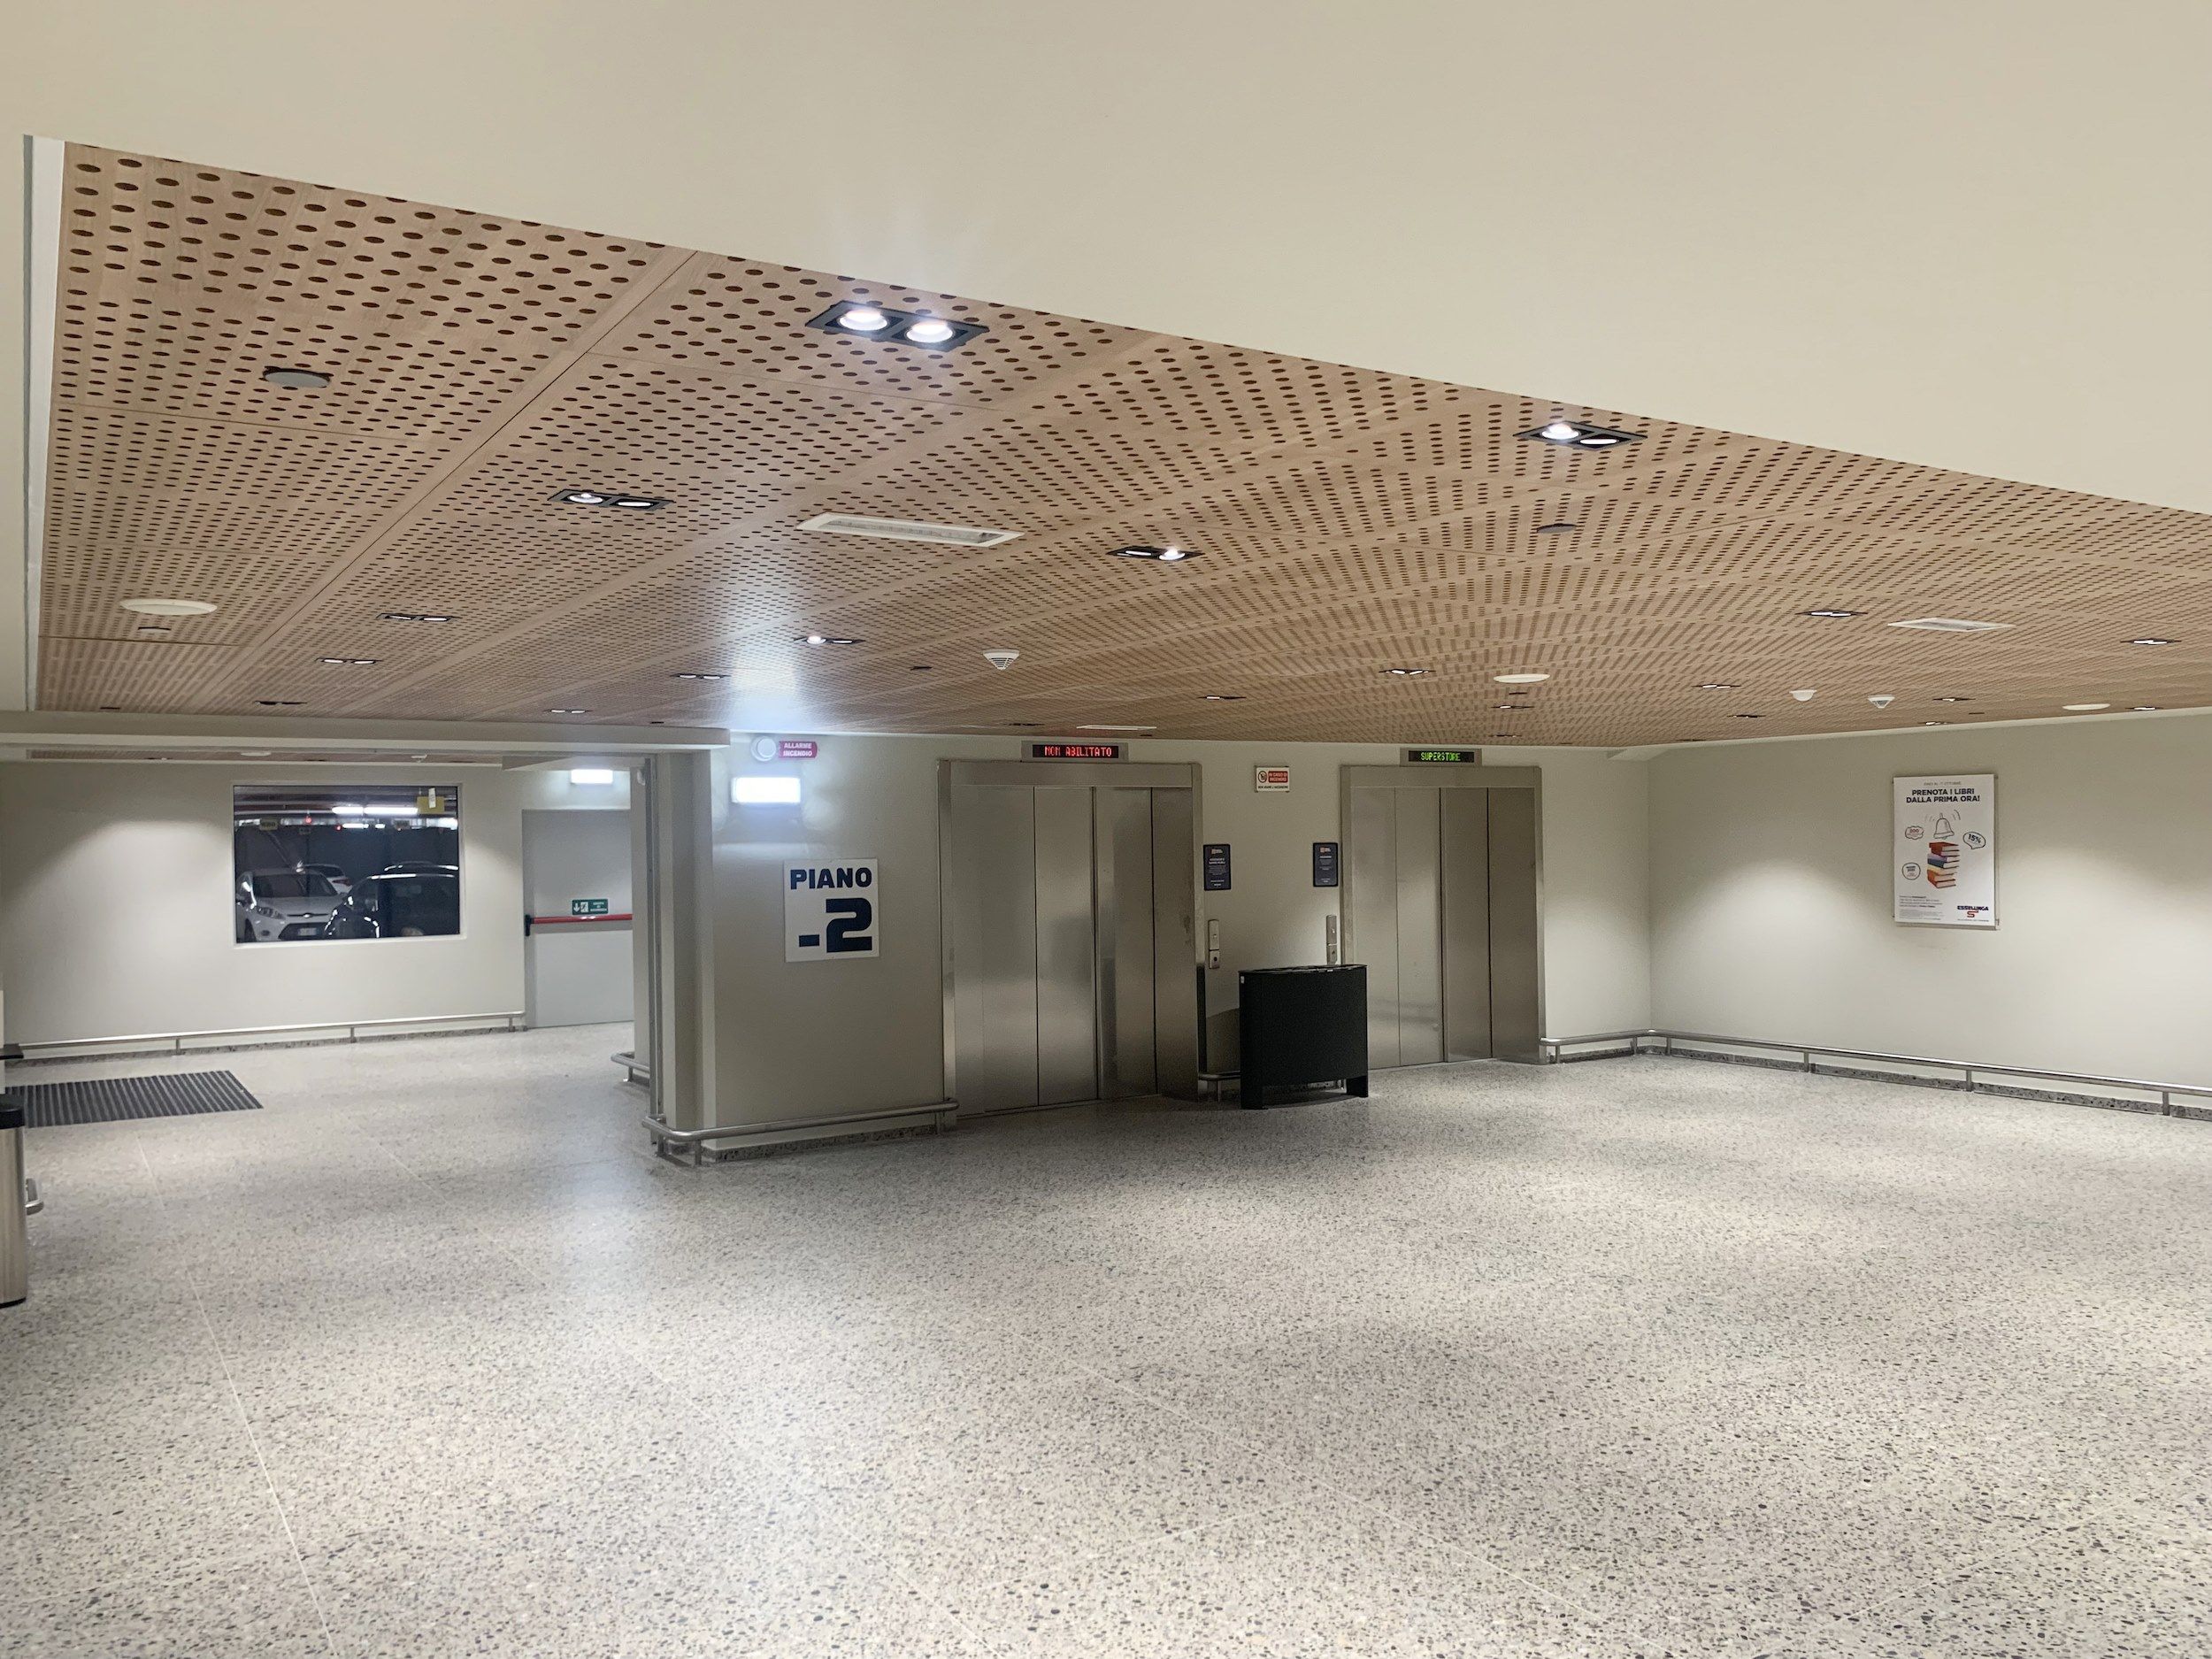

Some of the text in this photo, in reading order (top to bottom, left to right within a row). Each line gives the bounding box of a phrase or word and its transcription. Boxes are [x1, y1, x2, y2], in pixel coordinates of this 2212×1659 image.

[1044, 745, 1112, 757] NON ABILITATO
[1420, 751, 1461, 761] SUPERSTORE
[790, 867, 872, 890] PIANO
[798, 897, 872, 953] -2
